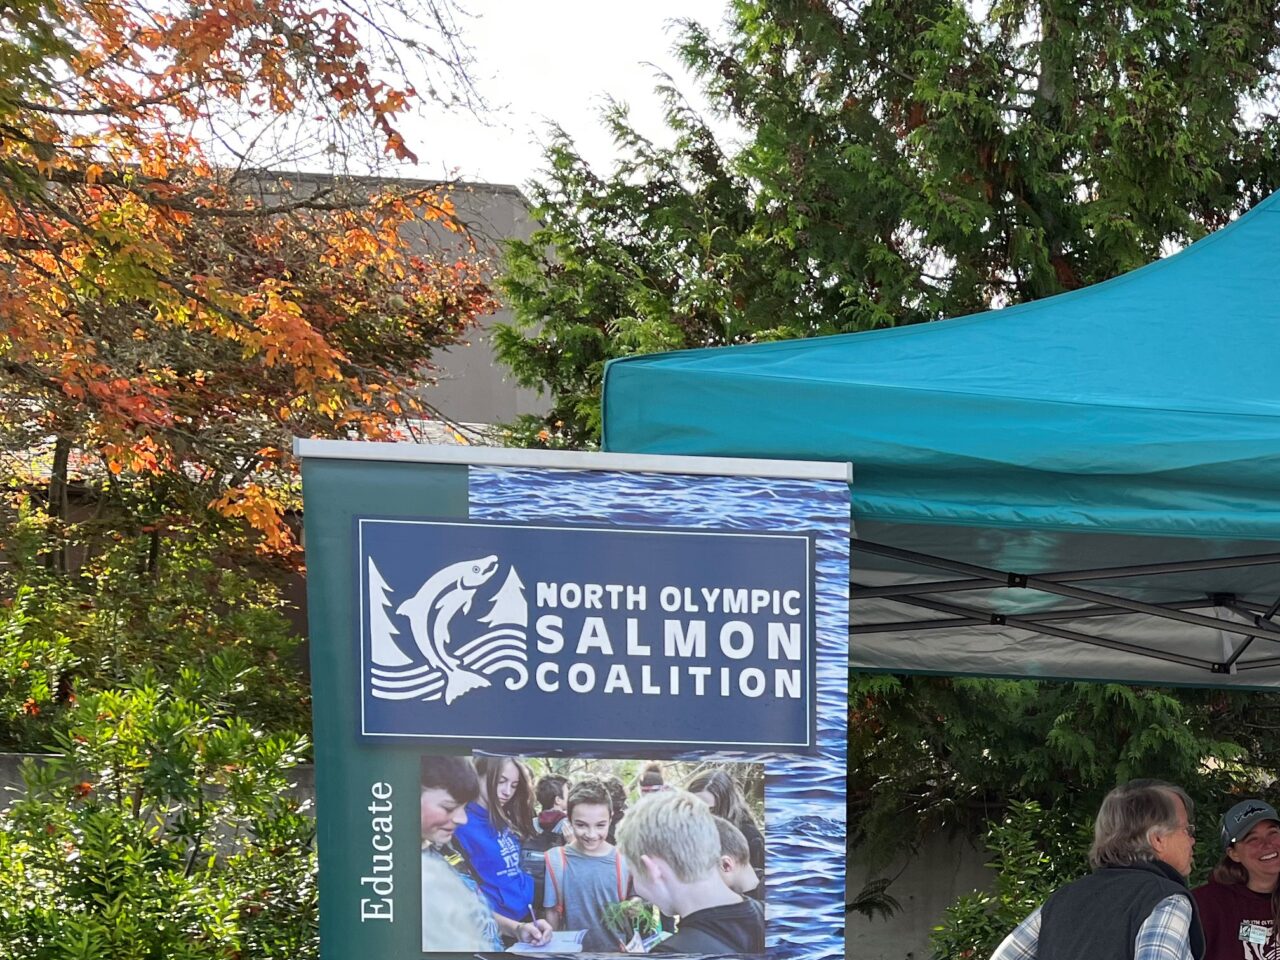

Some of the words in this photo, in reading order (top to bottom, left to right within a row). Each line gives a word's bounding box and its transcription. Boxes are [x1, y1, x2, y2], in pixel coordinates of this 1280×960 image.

[536, 582, 647, 611] NORTH
[659, 586, 801, 615] OLYMPIC
[535, 614, 801, 660] SALMON
[535, 662, 801, 698] COALITION
[360, 781, 394, 923] Educate
